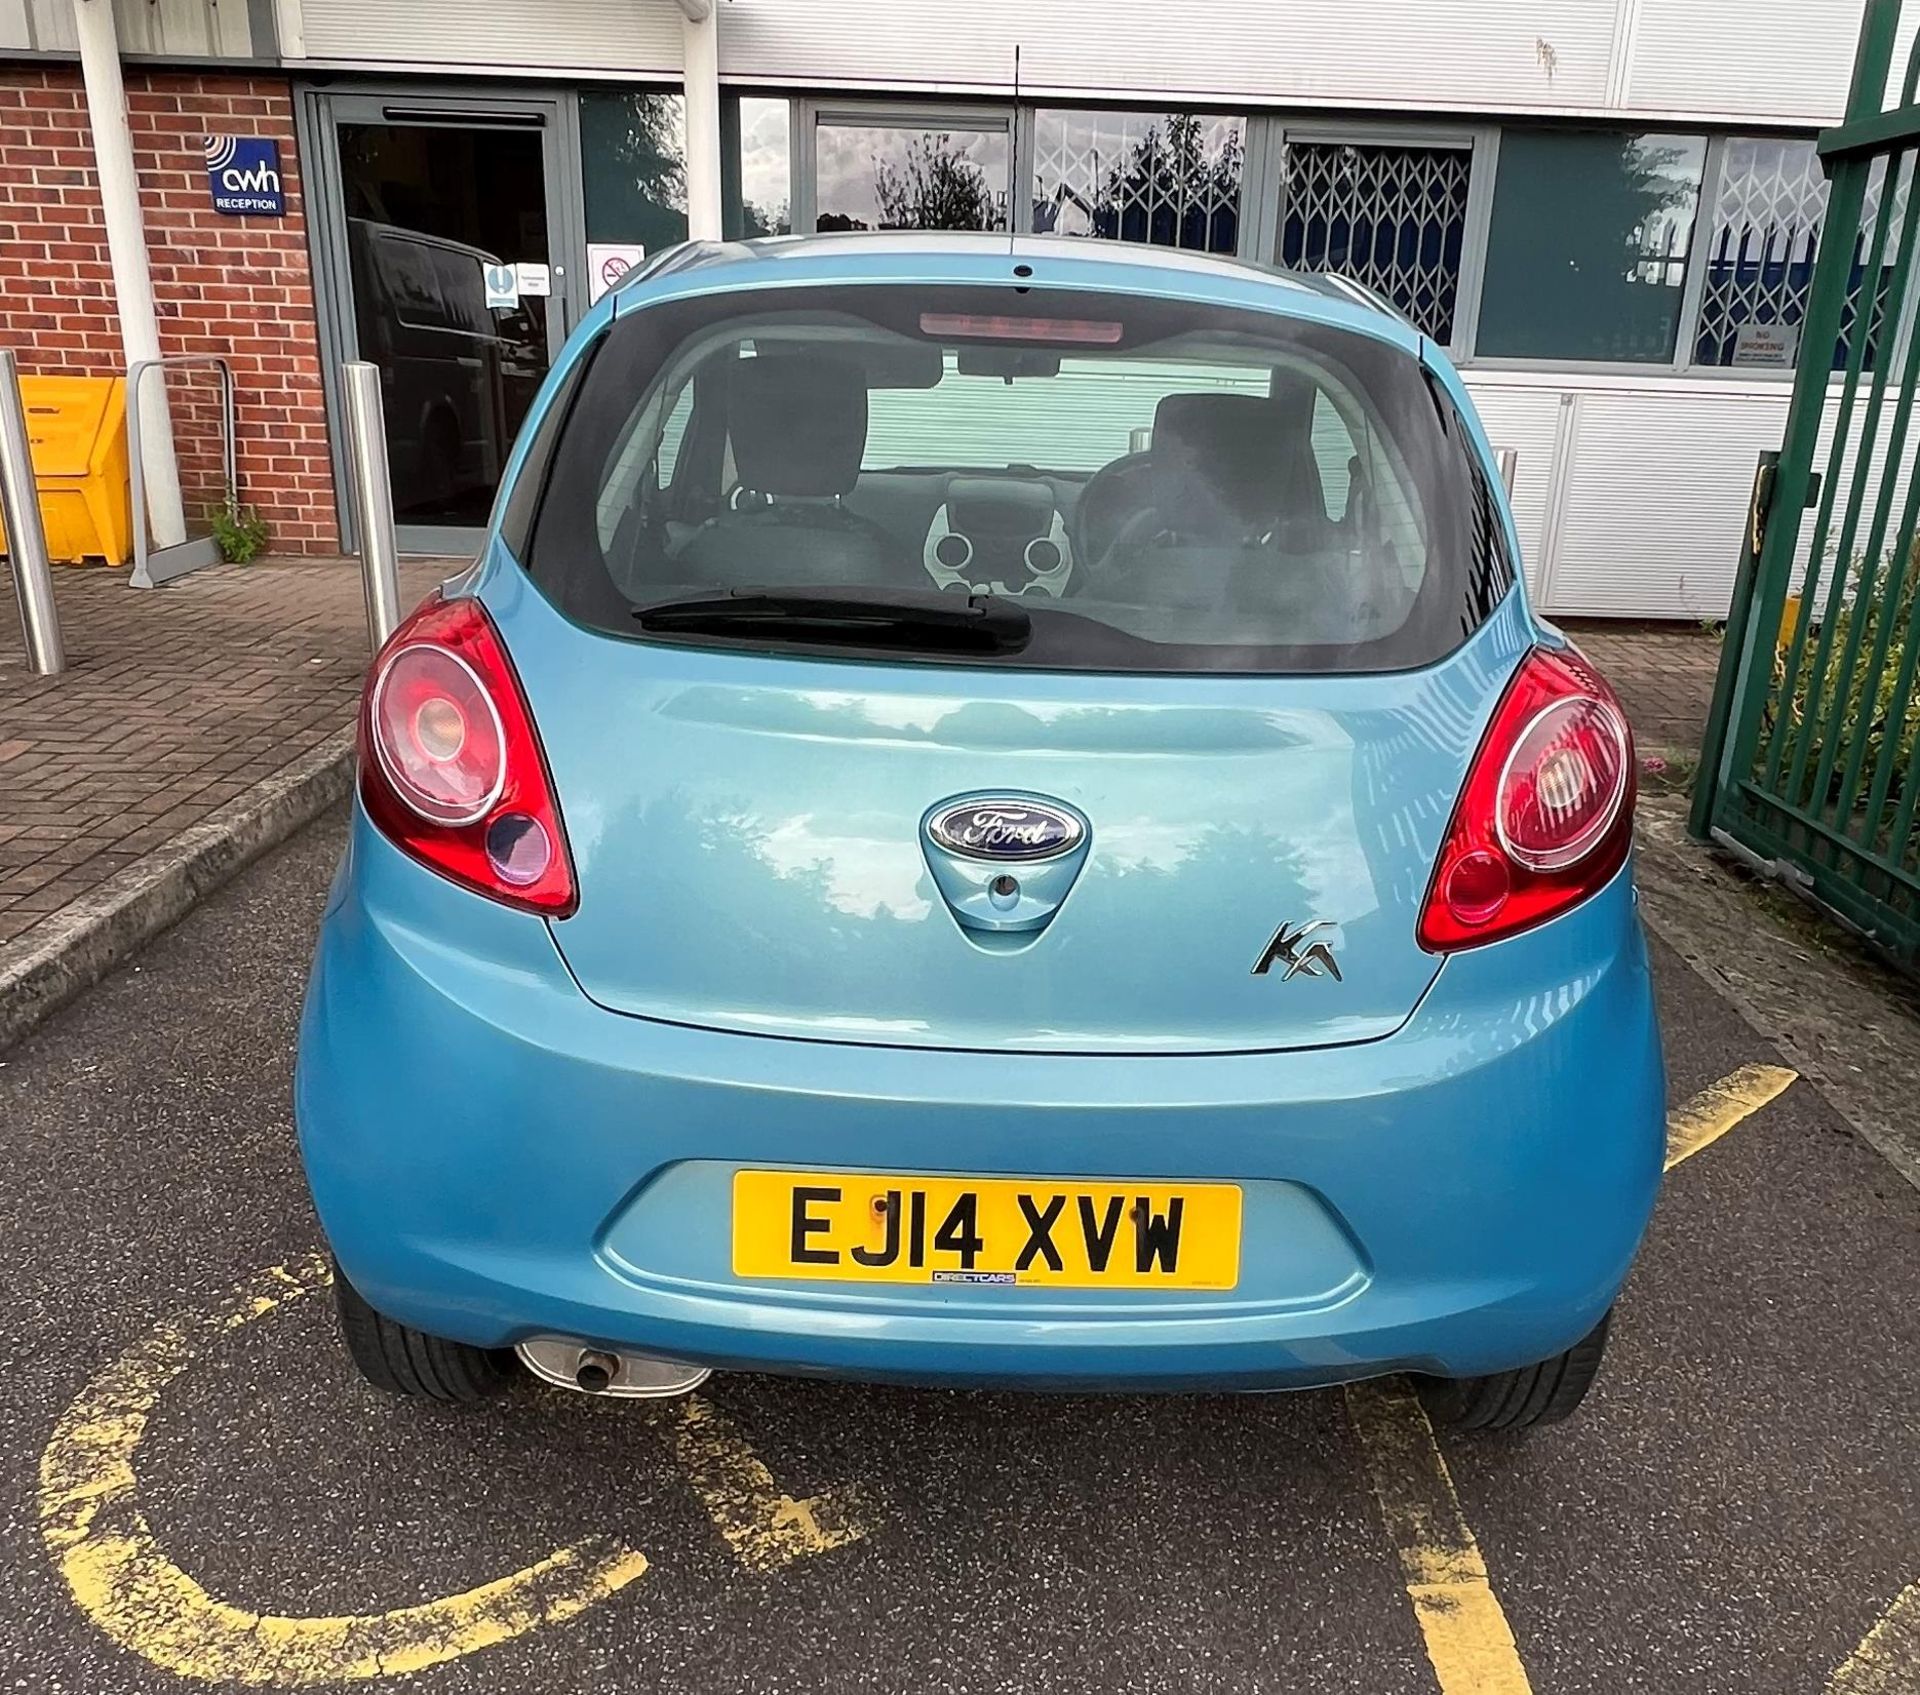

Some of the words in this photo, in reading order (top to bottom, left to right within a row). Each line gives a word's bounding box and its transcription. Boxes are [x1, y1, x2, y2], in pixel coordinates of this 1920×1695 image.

[222, 160, 280, 193] cwh
[215, 197, 277, 210] RECEPTION
[963, 811, 1048, 849] Ford
[790, 1186, 984, 1270] EJ14
[1015, 1194, 1185, 1273] XVW
